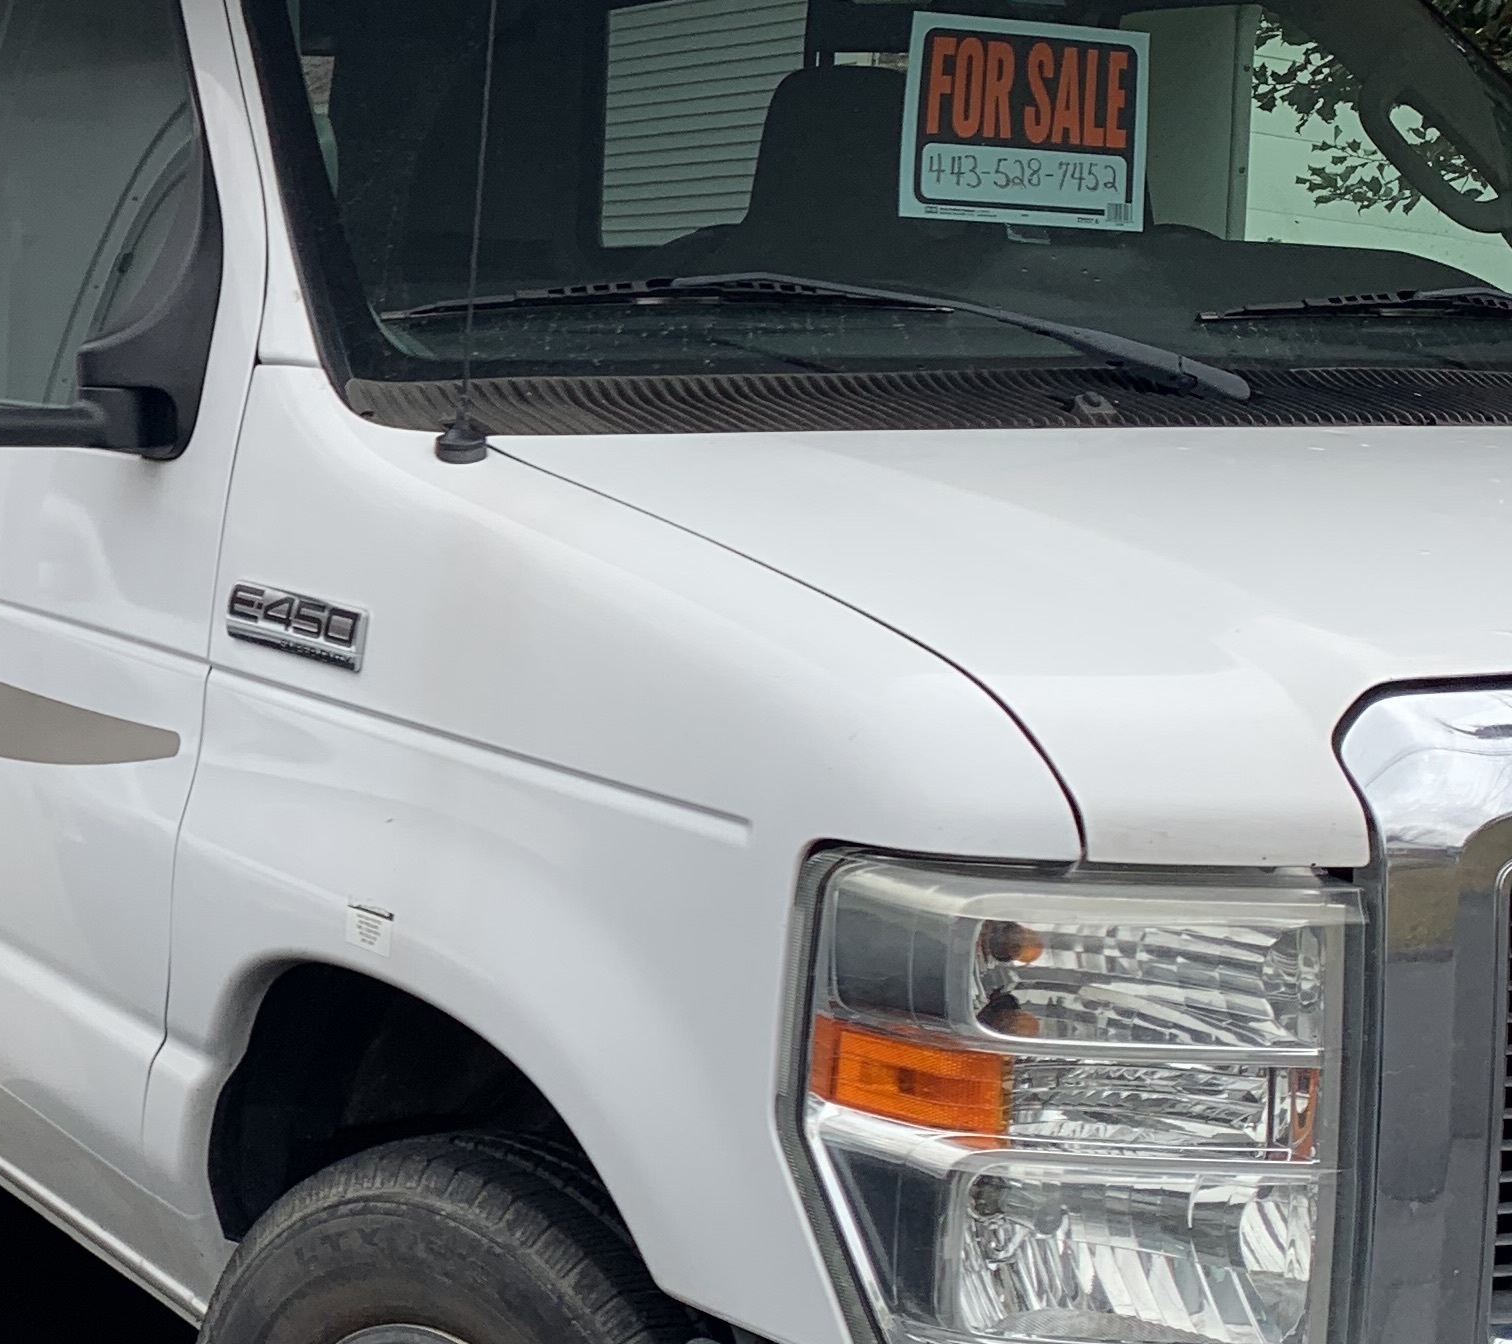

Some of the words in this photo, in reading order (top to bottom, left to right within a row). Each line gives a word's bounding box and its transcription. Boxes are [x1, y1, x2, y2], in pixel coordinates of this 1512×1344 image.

[926, 35, 1016, 139] FOR
[1022, 42, 1130, 149] SALE
[928, 153, 1119, 193] 443-528-7452
